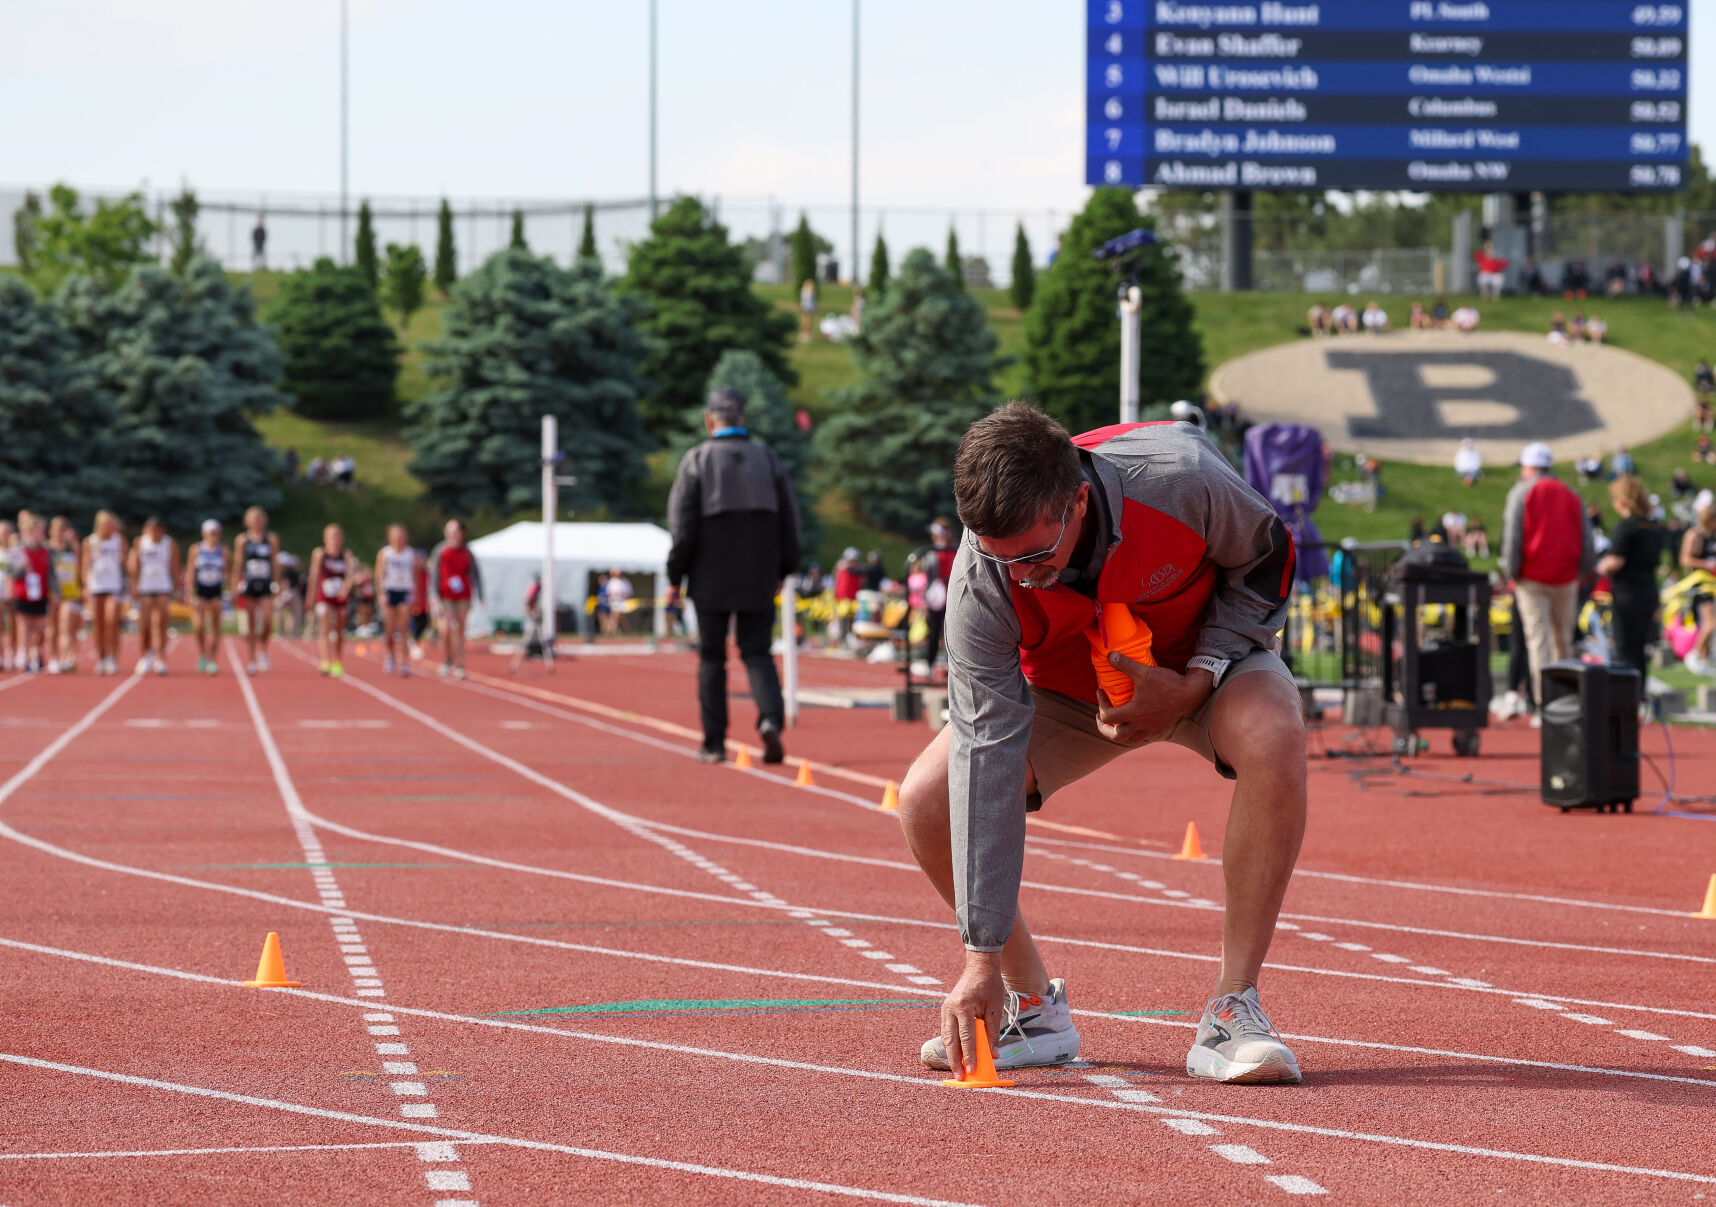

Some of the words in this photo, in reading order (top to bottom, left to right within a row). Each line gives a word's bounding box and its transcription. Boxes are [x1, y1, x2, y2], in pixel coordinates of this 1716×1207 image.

[1105, 0, 1123, 24] 3
[1260, 2, 1319, 25] Hunt
[1106, 33, 1122, 55] 4
[1156, 32, 1215, 56] Evan
[1217, 33, 1301, 57] Shaffer
[1410, 33, 1482, 55] Kearney
[1106, 64, 1123, 87] 5
[1155, 64, 1205, 88] Will
[1408, 65, 1473, 85] Omaha
[1105, 97, 1123, 119] 6
[1155, 96, 1220, 120] Israel
[1223, 97, 1306, 121] Daniels
[1408, 98, 1497, 117] Columbus
[1105, 128, 1122, 150] 7
[1241, 129, 1336, 153] Johnson
[1410, 129, 1475, 148] Millard
[1105, 161, 1122, 183] 8
[1153, 161, 1237, 186] Ahmad
[1241, 161, 1316, 185] Brown
[1408, 161, 1474, 181] Omaha
[1325, 350, 1605, 438] B
